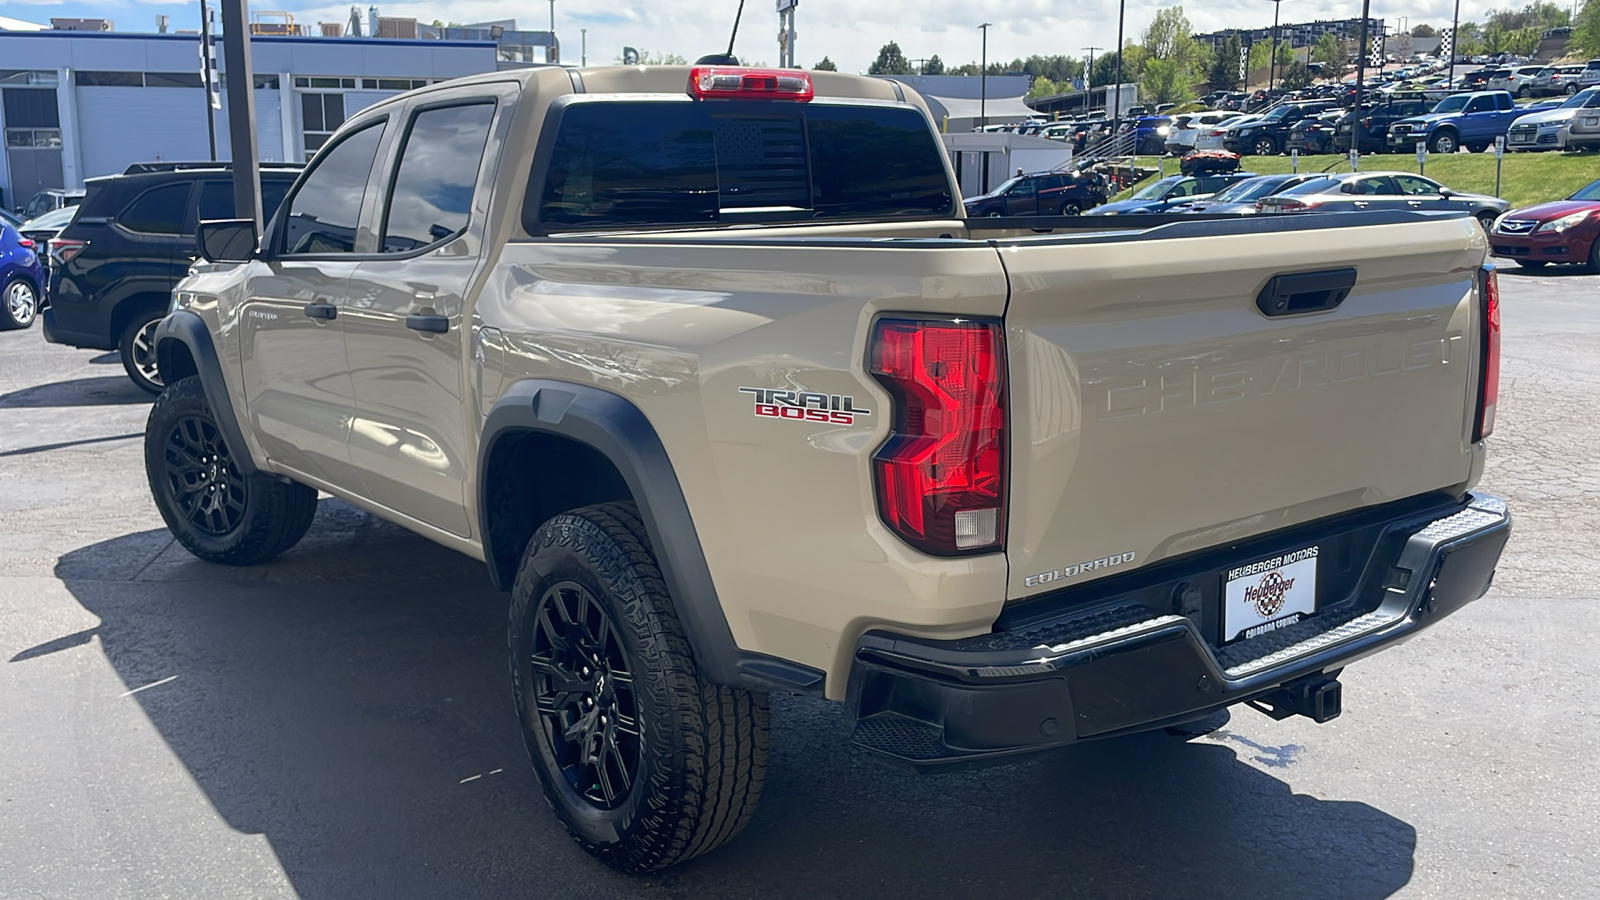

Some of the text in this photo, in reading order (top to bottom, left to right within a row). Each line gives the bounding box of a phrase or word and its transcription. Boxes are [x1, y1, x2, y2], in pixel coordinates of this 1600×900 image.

[1096, 330, 1462, 422] CHEVROLET
[738, 386, 871, 415] TRAIL
[754, 403, 854, 426] BOSS
[1024, 550, 1136, 588] COLORADO
[1228, 556, 1282, 581] HEUBERGER
[1283, 545, 1319, 566] MOTORS
[1243, 577, 1296, 603] Heuberger
[1245, 622, 1275, 639] COLORADO
